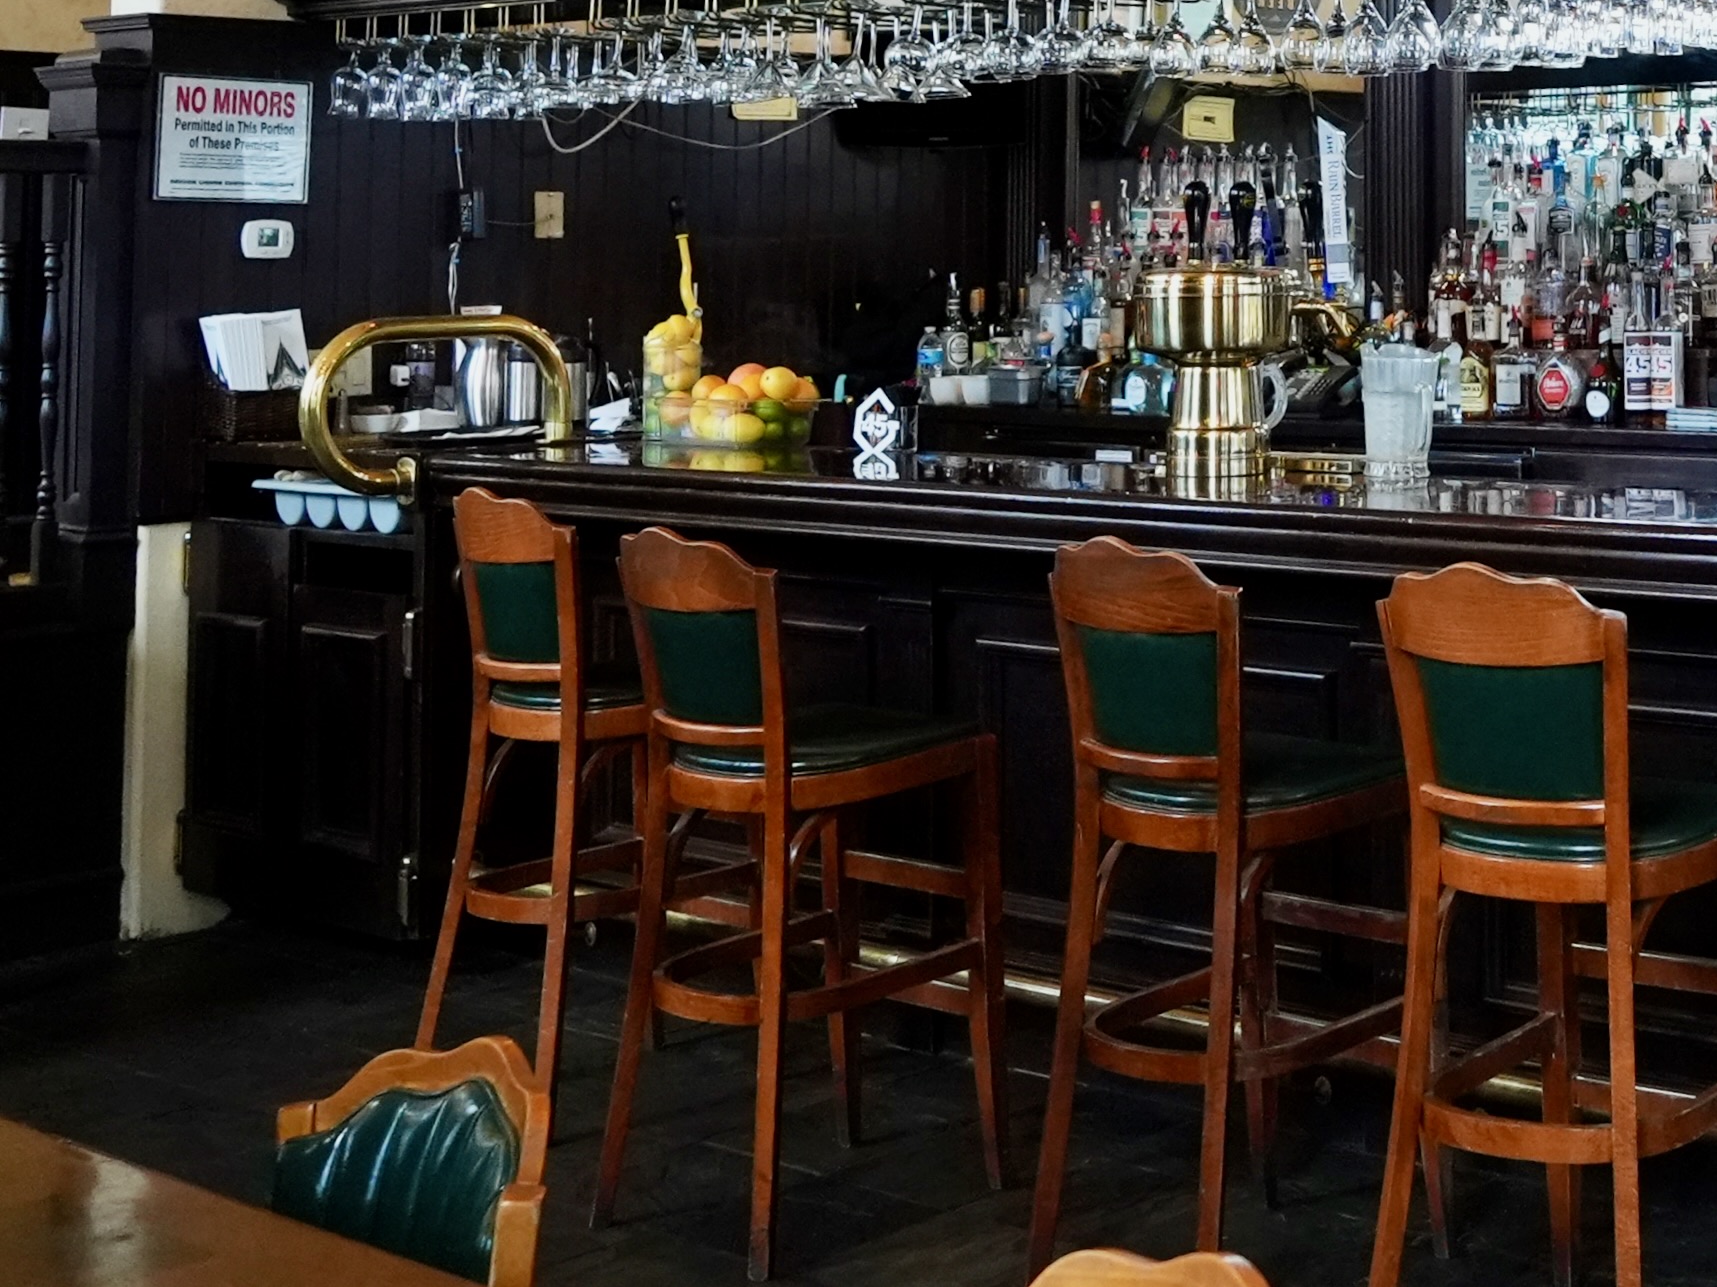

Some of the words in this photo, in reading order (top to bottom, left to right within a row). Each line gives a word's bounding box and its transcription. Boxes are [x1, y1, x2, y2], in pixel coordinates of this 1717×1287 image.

[176, 84, 208, 115] NO
[213, 87, 297, 119] MINORS
[174, 117, 223, 132] Permitted
[225, 121, 235, 133] in
[237, 120, 258, 134] This
[260, 122, 295, 135] Portion
[189, 136, 199, 149] of
[202, 136, 232, 150] These
